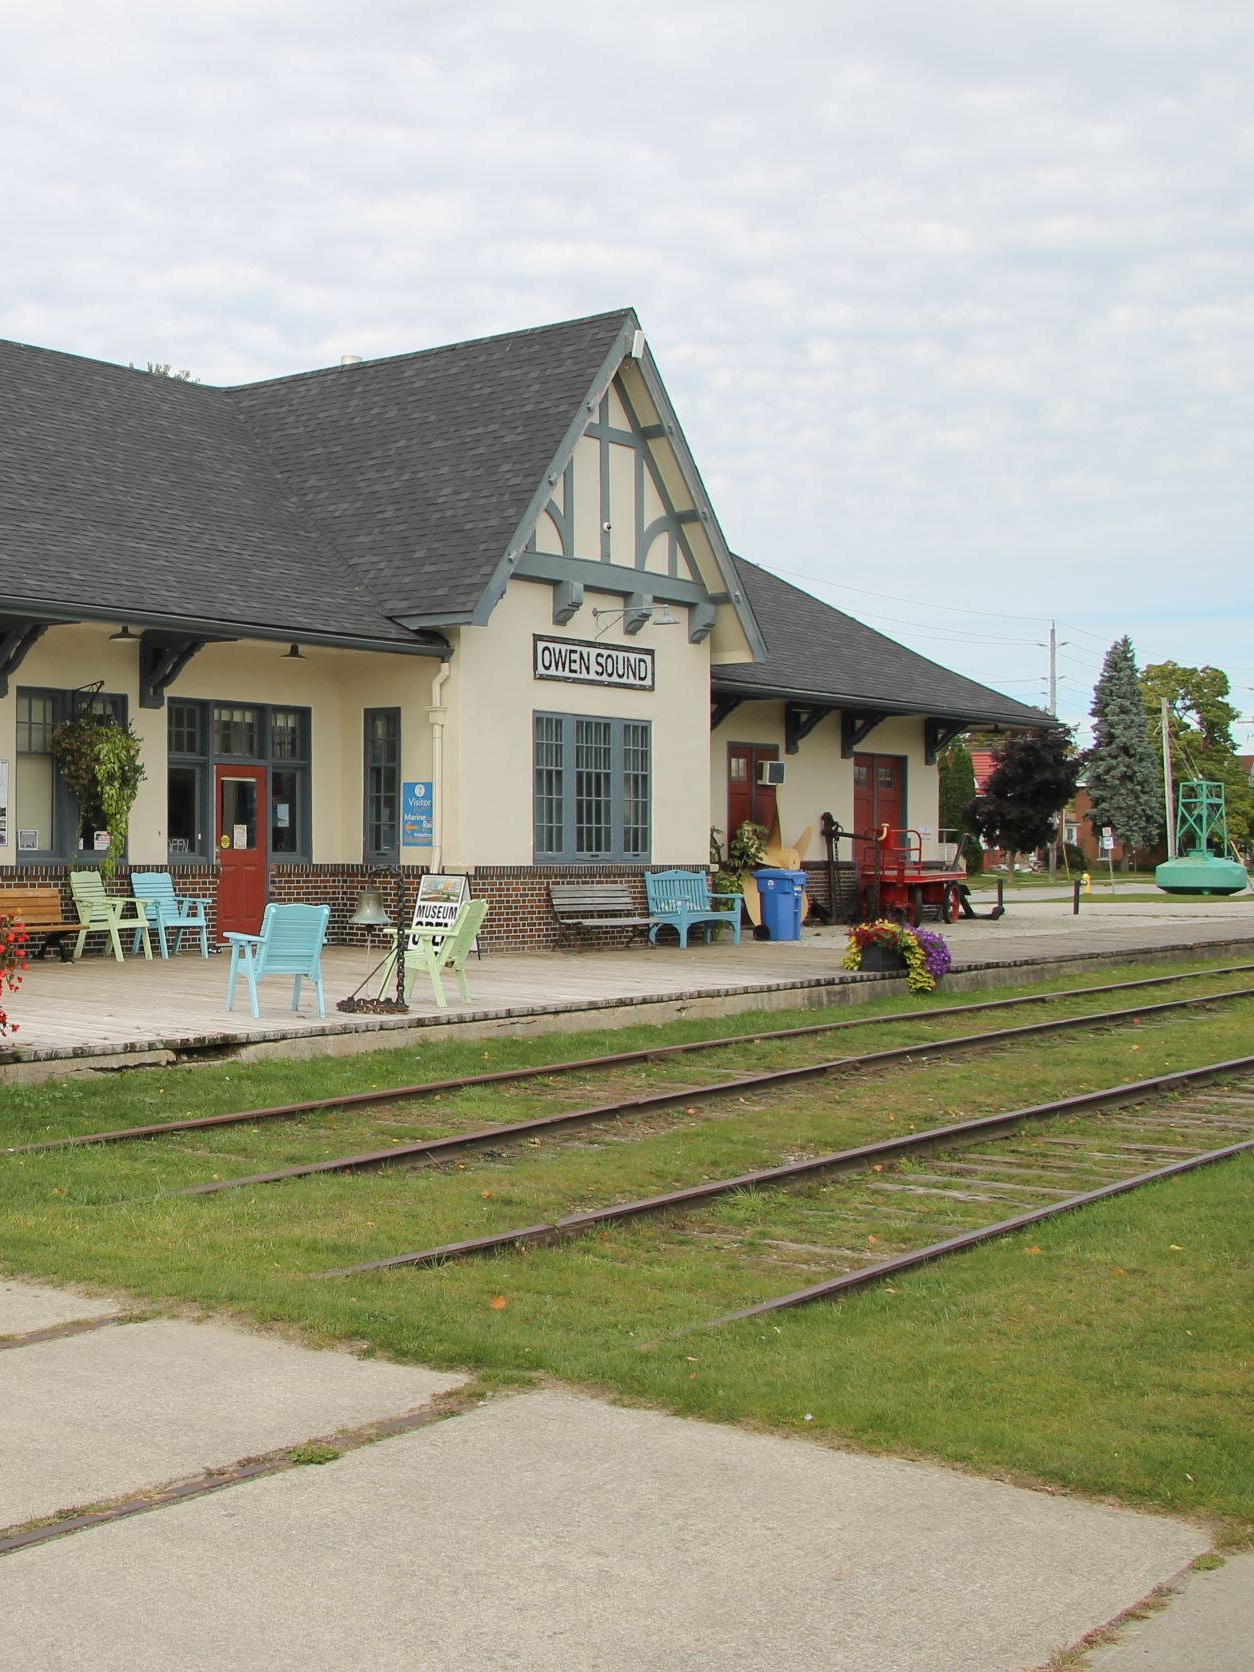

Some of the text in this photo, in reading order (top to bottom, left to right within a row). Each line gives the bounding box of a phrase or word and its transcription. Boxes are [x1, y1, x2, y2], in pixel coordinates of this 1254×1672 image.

[541, 646, 648, 681] OWEN SOUND
[408, 797, 431, 807] Visitor
[404, 813, 426, 821] Marine
[422, 820, 433, 828] Rai
[416, 905, 458, 920] MUSEUM
